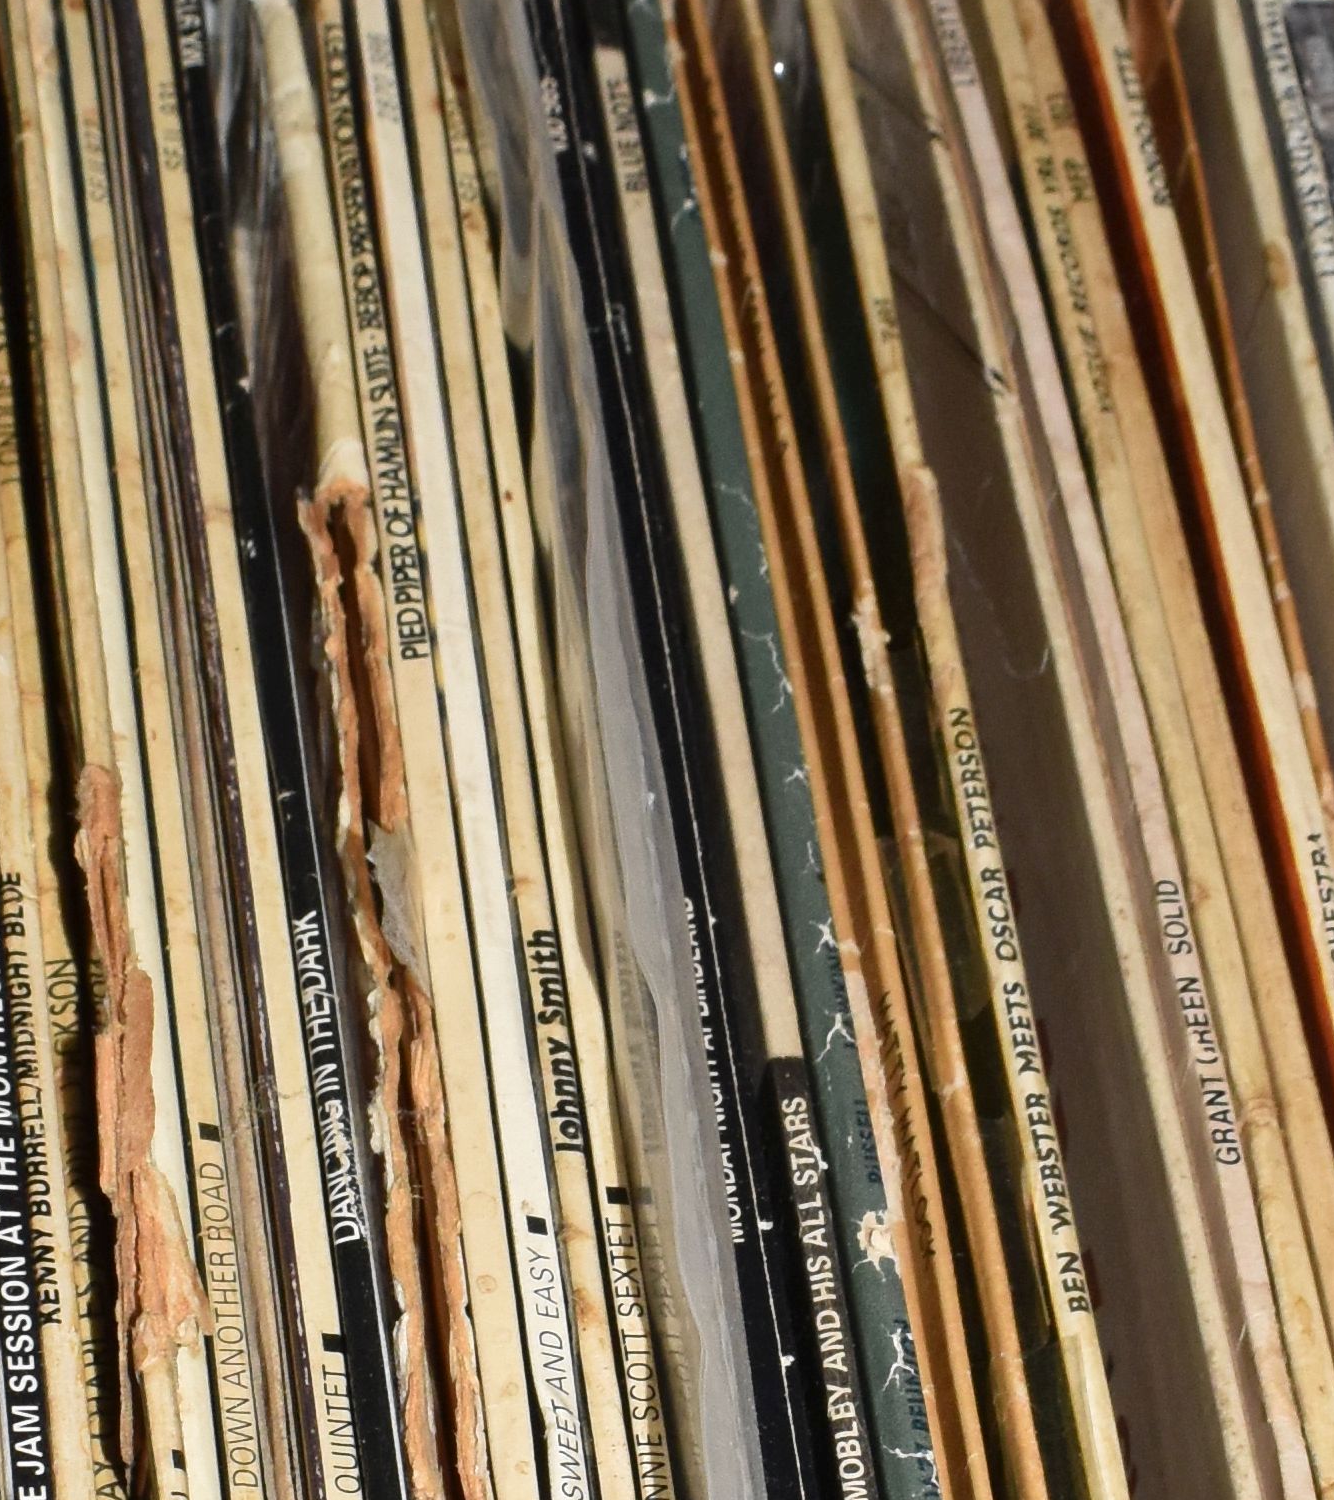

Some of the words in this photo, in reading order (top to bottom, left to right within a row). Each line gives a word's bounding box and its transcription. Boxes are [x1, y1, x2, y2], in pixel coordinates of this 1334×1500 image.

[386, 539, 424, 606] PIPER
[394, 607, 432, 661] PIED
[947, 705, 998, 848] PETERSON
[979, 864, 1020, 963] OSCAR
[1153, 877, 1196, 955] SOLID
[1002, 981, 1042, 1074] MEETS
[780, 1095, 820, 1186] STARS
[1024, 1090, 1074, 1235] WEBSTER
[1198, 1075, 1244, 1165] GRANT
[796, 1191, 830, 1248] ALL
[525, 1245, 560, 1318] EASY
[604, 1215, 646, 1318] SEXTET
[806, 1252, 838, 1300] HIS
[1056, 1248, 1090, 1314] BEN
[207, 1246, 249, 1388] ANOTHER
[536, 1328, 570, 1394] AND
[815, 1307, 850, 1371] AND
[621, 1327, 662, 1422] SCOTT
[10, 1403, 46, 1475] JAM
[223, 1393, 260, 1488] DOWN
[322, 1361, 365, 1493] QUINTET
[546, 1399, 585, 1500] SWEET
